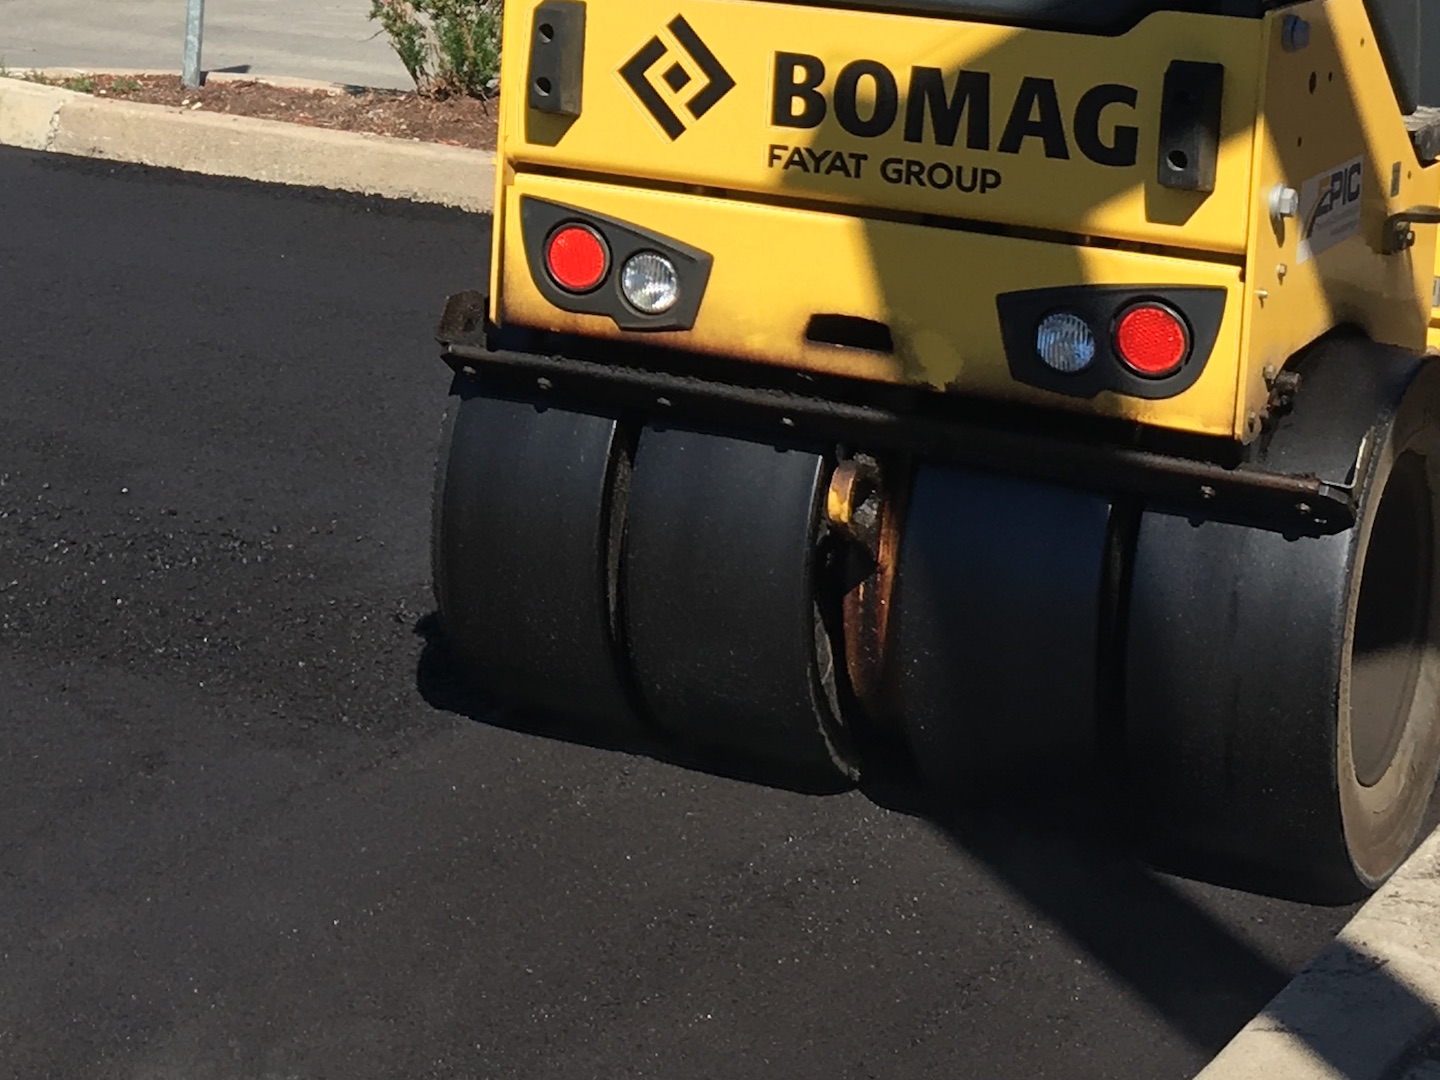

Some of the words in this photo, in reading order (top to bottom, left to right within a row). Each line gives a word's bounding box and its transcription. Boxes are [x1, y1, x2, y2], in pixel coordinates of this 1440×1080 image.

[770, 50, 1140, 168] BOMAG
[766, 143, 868, 180] FAYAT
[879, 156, 1002, 194] GROUP
